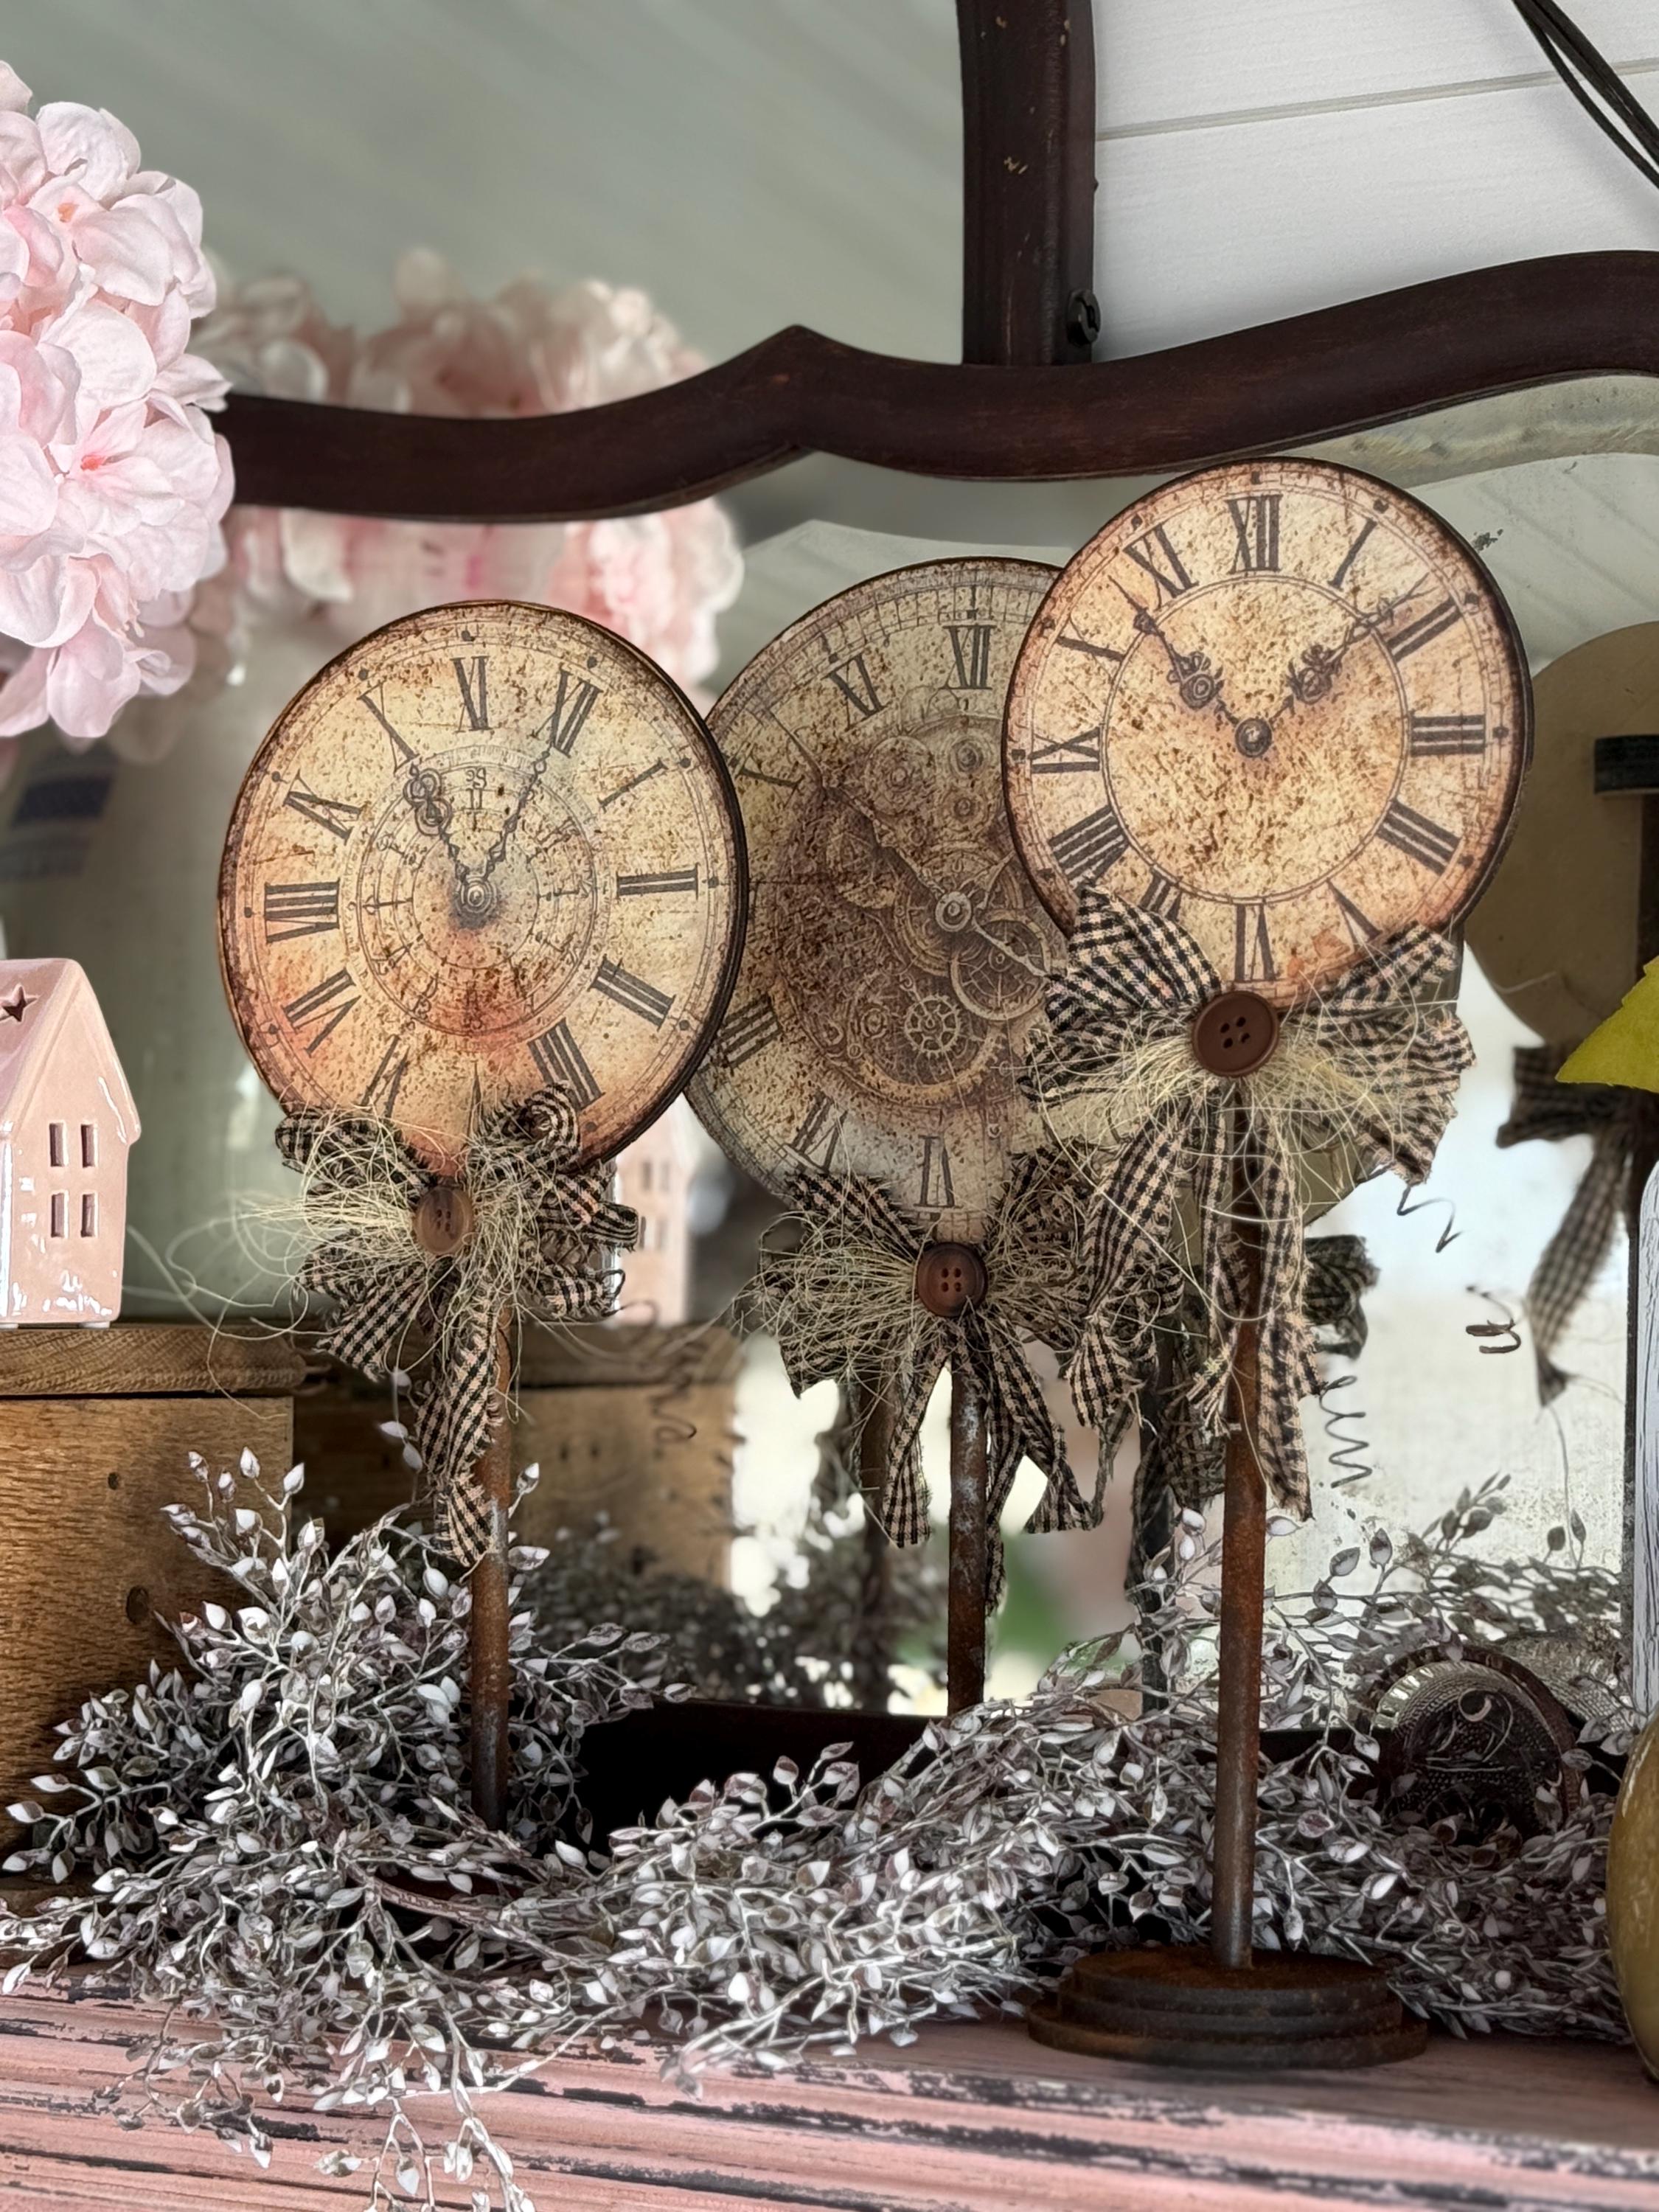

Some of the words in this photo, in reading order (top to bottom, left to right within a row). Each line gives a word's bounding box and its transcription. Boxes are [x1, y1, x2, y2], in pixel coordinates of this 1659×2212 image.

[1122, 520, 1200, 611] XI
[1224, 493, 1283, 574] XII
[1328, 517, 1378, 590] I
[942, 624, 997, 690] XII
[1384, 594, 1462, 664] II
[357, 678, 420, 776] X
[451, 655, 490, 733] XI
[529, 666, 603, 758] XII
[819, 647, 892, 733] XI
[1029, 725, 1103, 775] IX
[1408, 711, 1486, 756] III
[282, 769, 368, 843] IX
[1375, 798, 1465, 879] III
[263, 877, 341, 944] VIII
[615, 861, 699, 901] II
[1227, 901, 1284, 984] VI
[280, 967, 364, 1058] VII
[587, 953, 677, 1032] III
[913, 1134, 962, 1209] VI
